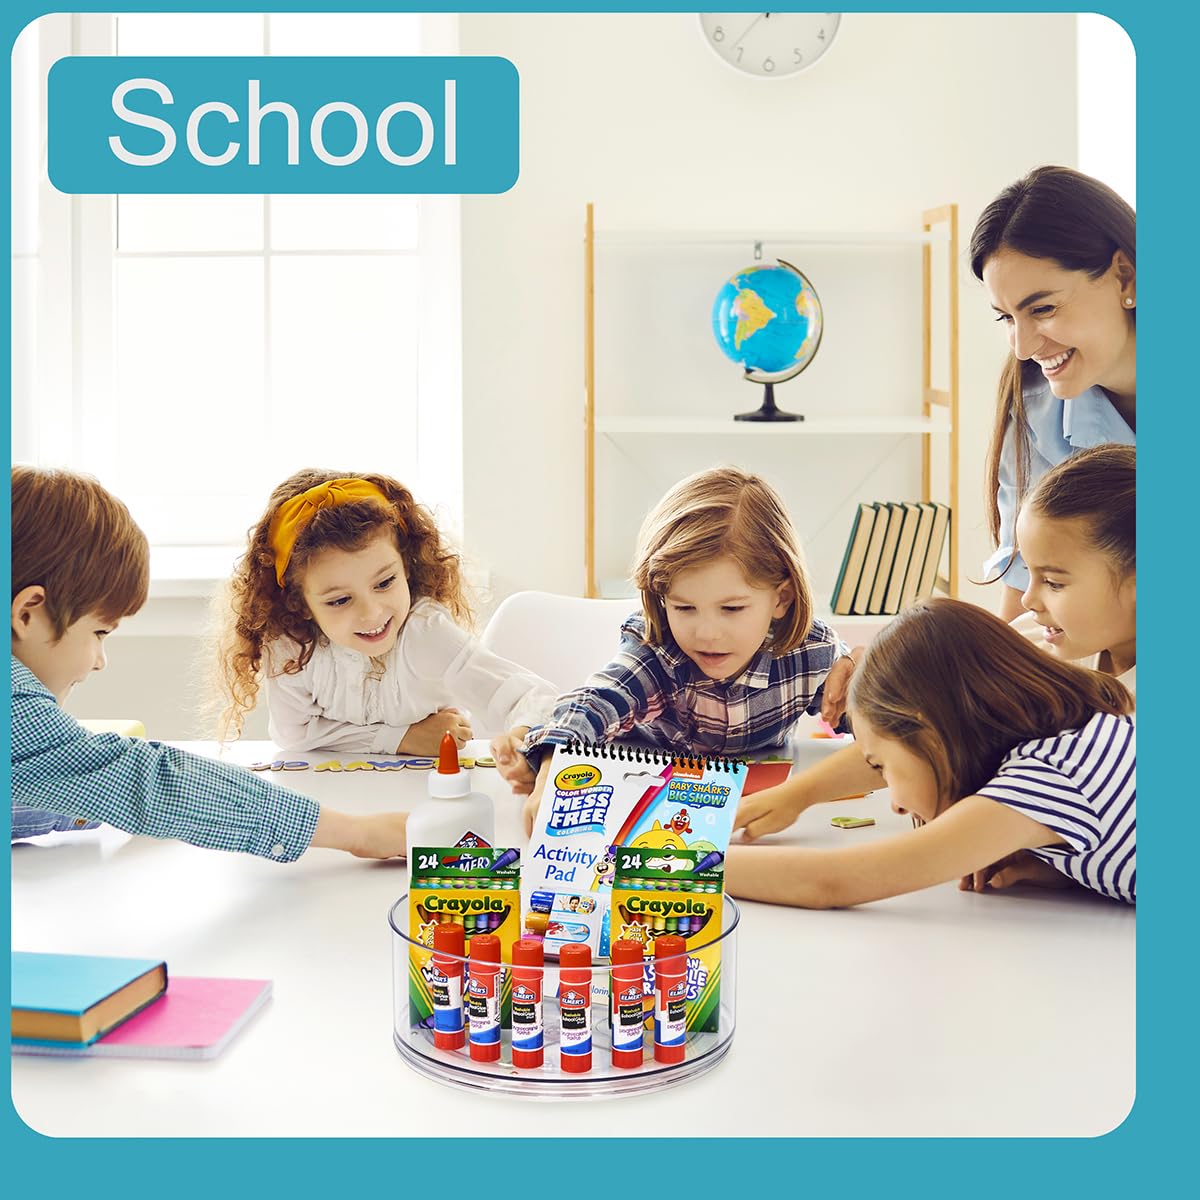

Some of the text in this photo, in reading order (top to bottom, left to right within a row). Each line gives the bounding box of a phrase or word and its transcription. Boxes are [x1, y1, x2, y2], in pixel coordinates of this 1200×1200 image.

[712, 25, 726, 42] 8
[736, 46, 744, 63] 7
[793, 48, 804, 64] 5
[762, 56, 776, 72] 6
[563, 771, 593, 780] Crayola
[580, 786, 613, 794] WONDER
[670, 781, 730, 796] BABY SHARK'S
[553, 793, 610, 812] MESS
[668, 790, 727, 806] BIG SHOW!
[550, 808, 606, 828] FREE
[418, 854, 439, 870] 24
[533, 844, 598, 868] Activity
[621, 854, 642, 870] 24
[544, 864, 577, 883] Pad
[424, 896, 504, 915] Crayola
[626, 896, 706, 917] Crayola
